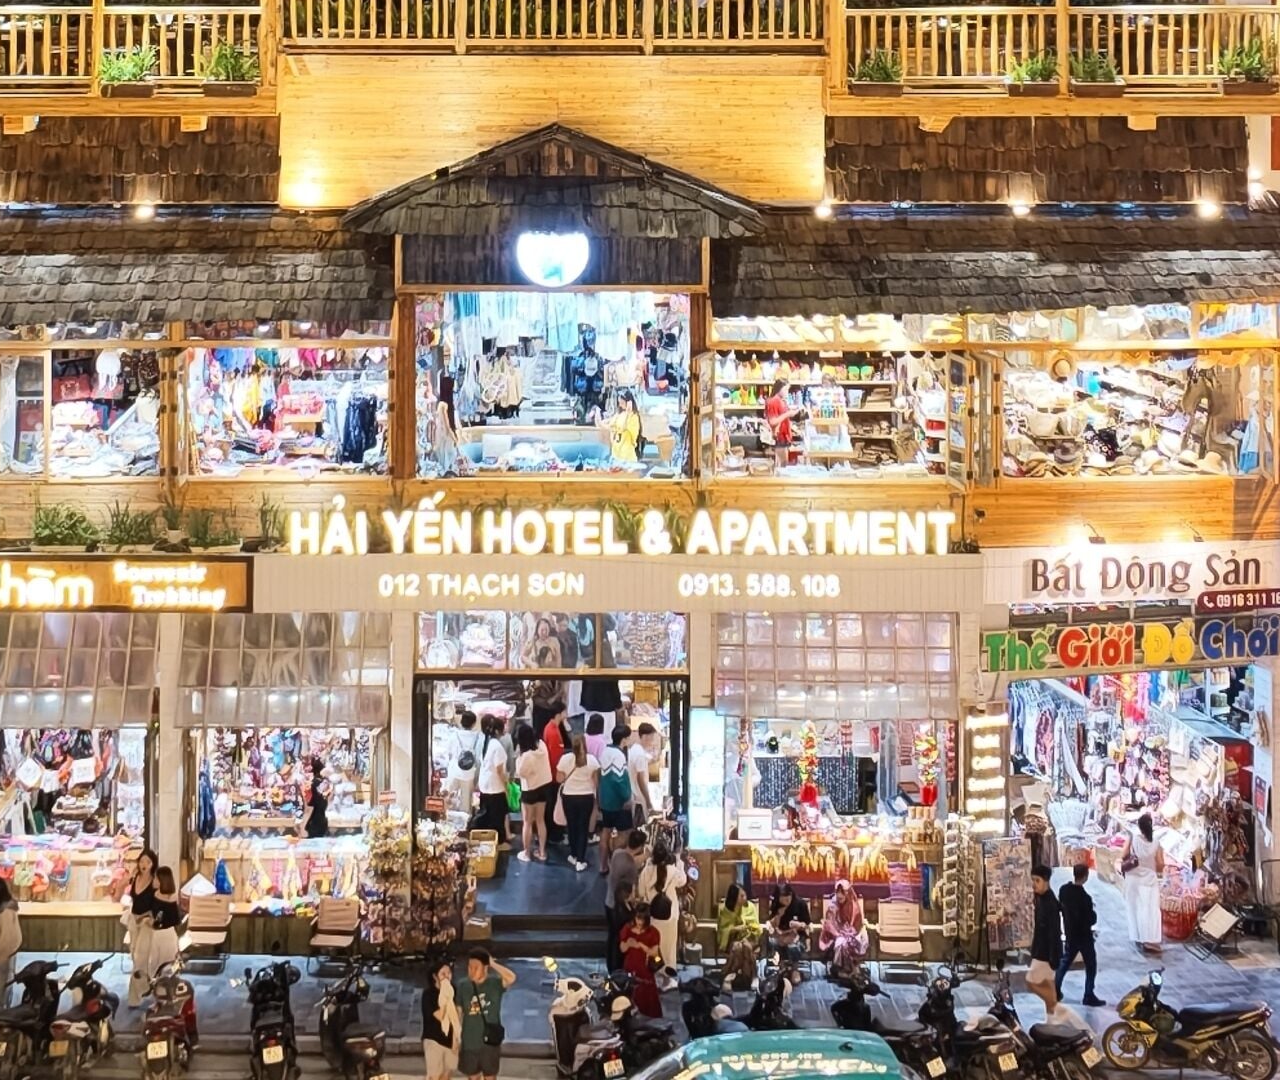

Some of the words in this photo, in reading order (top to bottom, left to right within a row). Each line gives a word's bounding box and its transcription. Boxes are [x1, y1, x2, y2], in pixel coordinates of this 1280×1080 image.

[290, 495, 368, 555] HẢI
[381, 490, 472, 555] YẾN
[482, 510, 628, 555] HOTEL
[639, 510, 672, 555] &
[686, 510, 956, 555] APARTMENT
[379, 573, 419, 596] 012
[427, 573, 519, 602] THẠCH
[527, 571, 585, 596] SƠN
[800, 574, 840, 597] 108
[1099, 555, 1192, 596] Động
[1204, 550, 1261, 587] Sản
[1217, 593, 1244, 608] 0916
[1246, 592, 1267, 606] 311
[984, 624, 1057, 671] Thế
[1057, 622, 1135, 669] Giới
